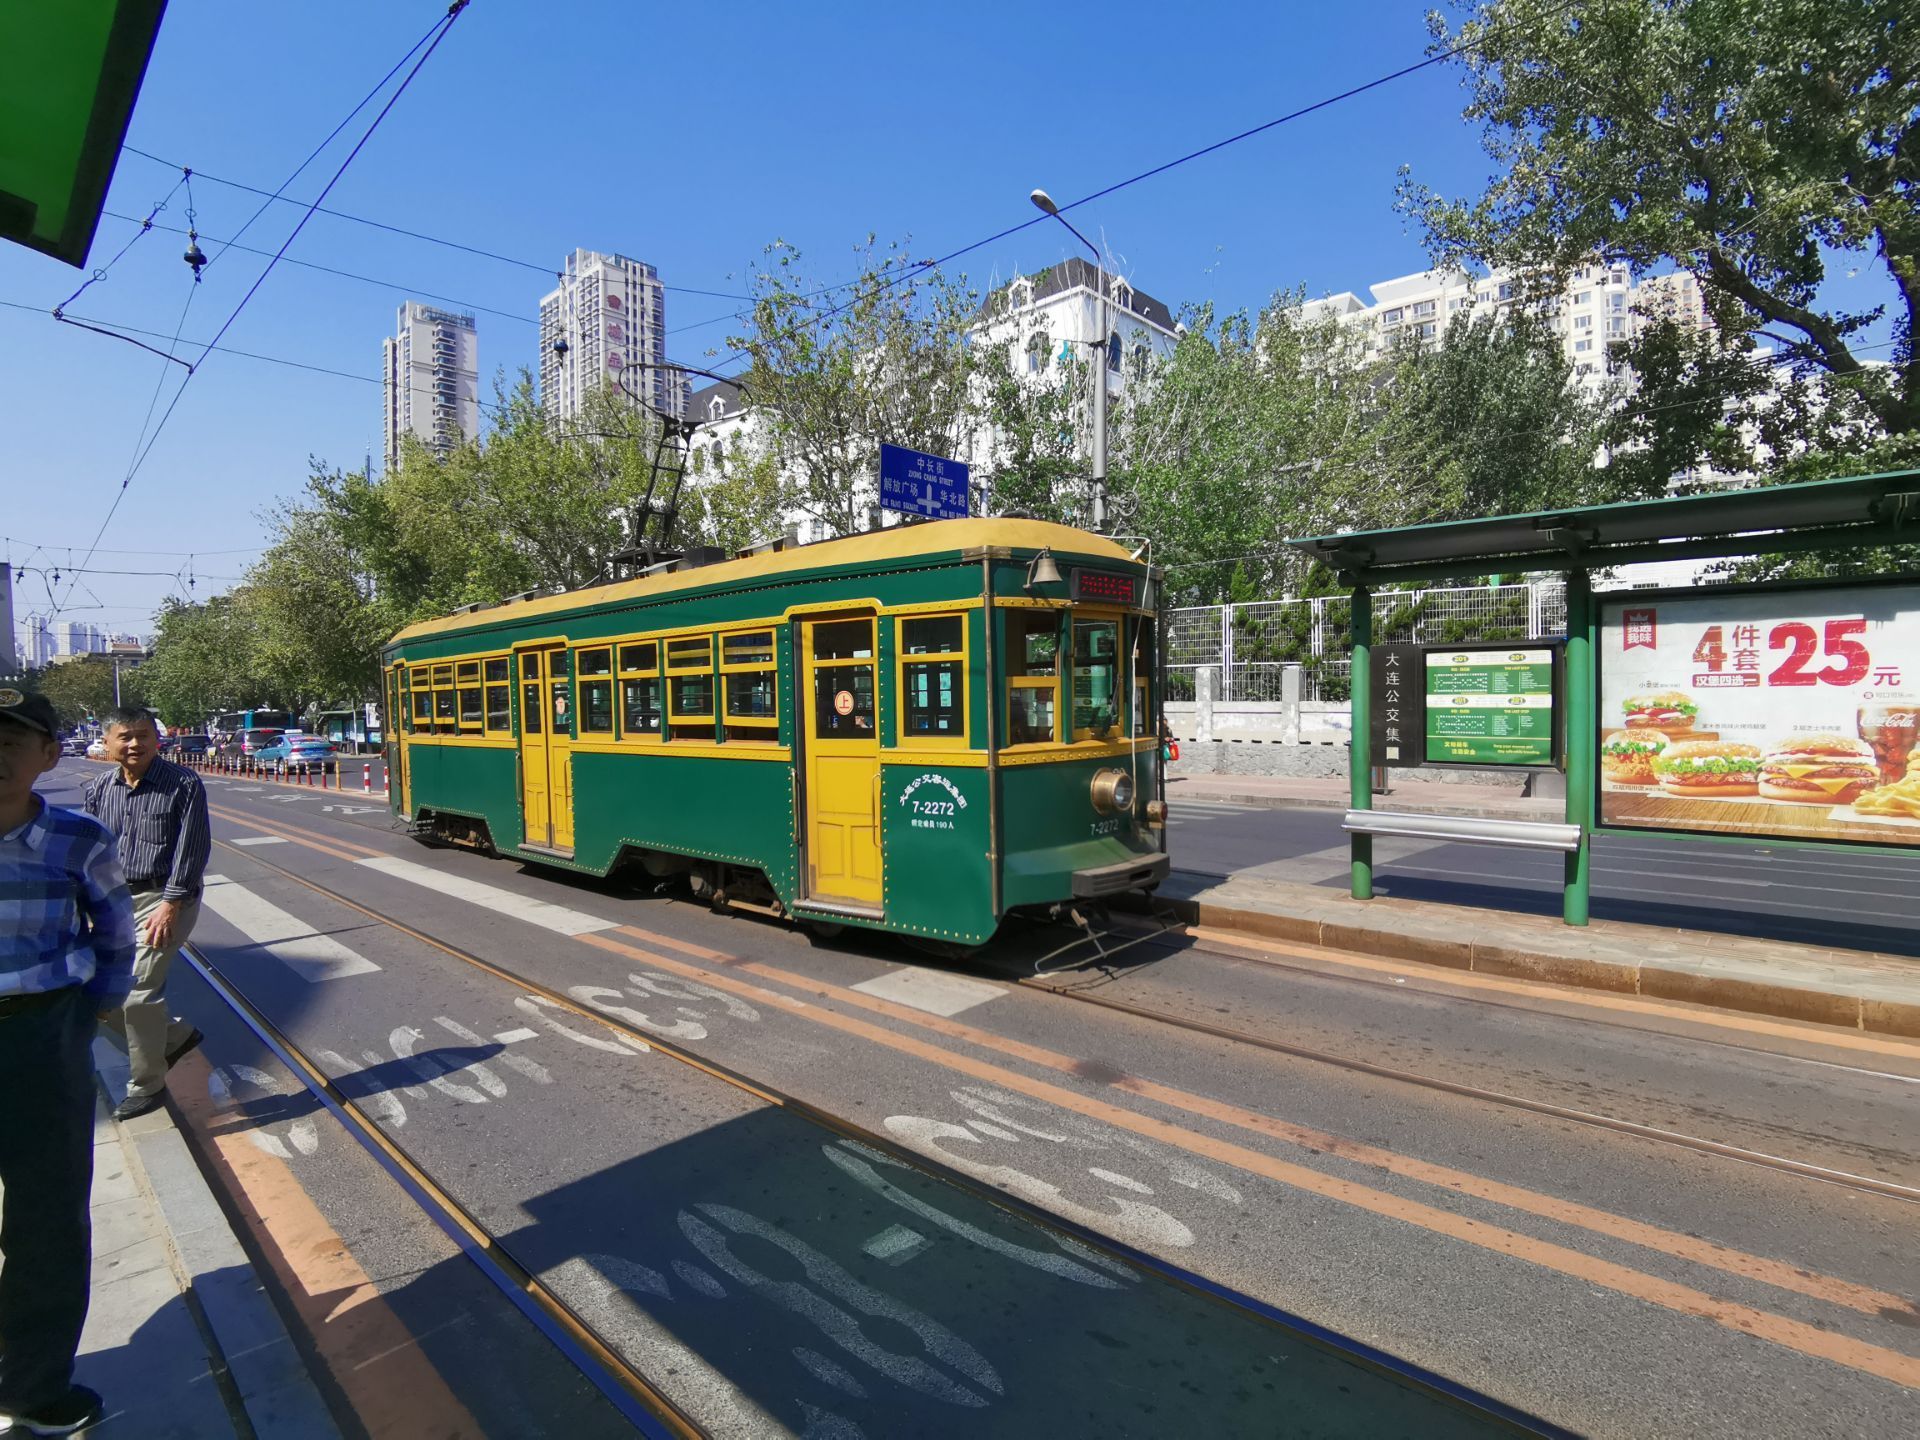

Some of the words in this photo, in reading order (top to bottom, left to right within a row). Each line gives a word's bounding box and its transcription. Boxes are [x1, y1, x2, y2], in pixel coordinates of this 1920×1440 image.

[917, 457, 944, 475] 中长街
[883, 476, 919, 497] 解放广场
[940, 490, 966, 508] 华北路
[1695, 674, 1757, 687] 汉堡四选一
[839, 695, 849, 708] 上
[1385, 652, 1401, 760] 大连公交集
[912, 801, 955, 816] 7-2272
[1089, 818, 1120, 836] 7-2272
